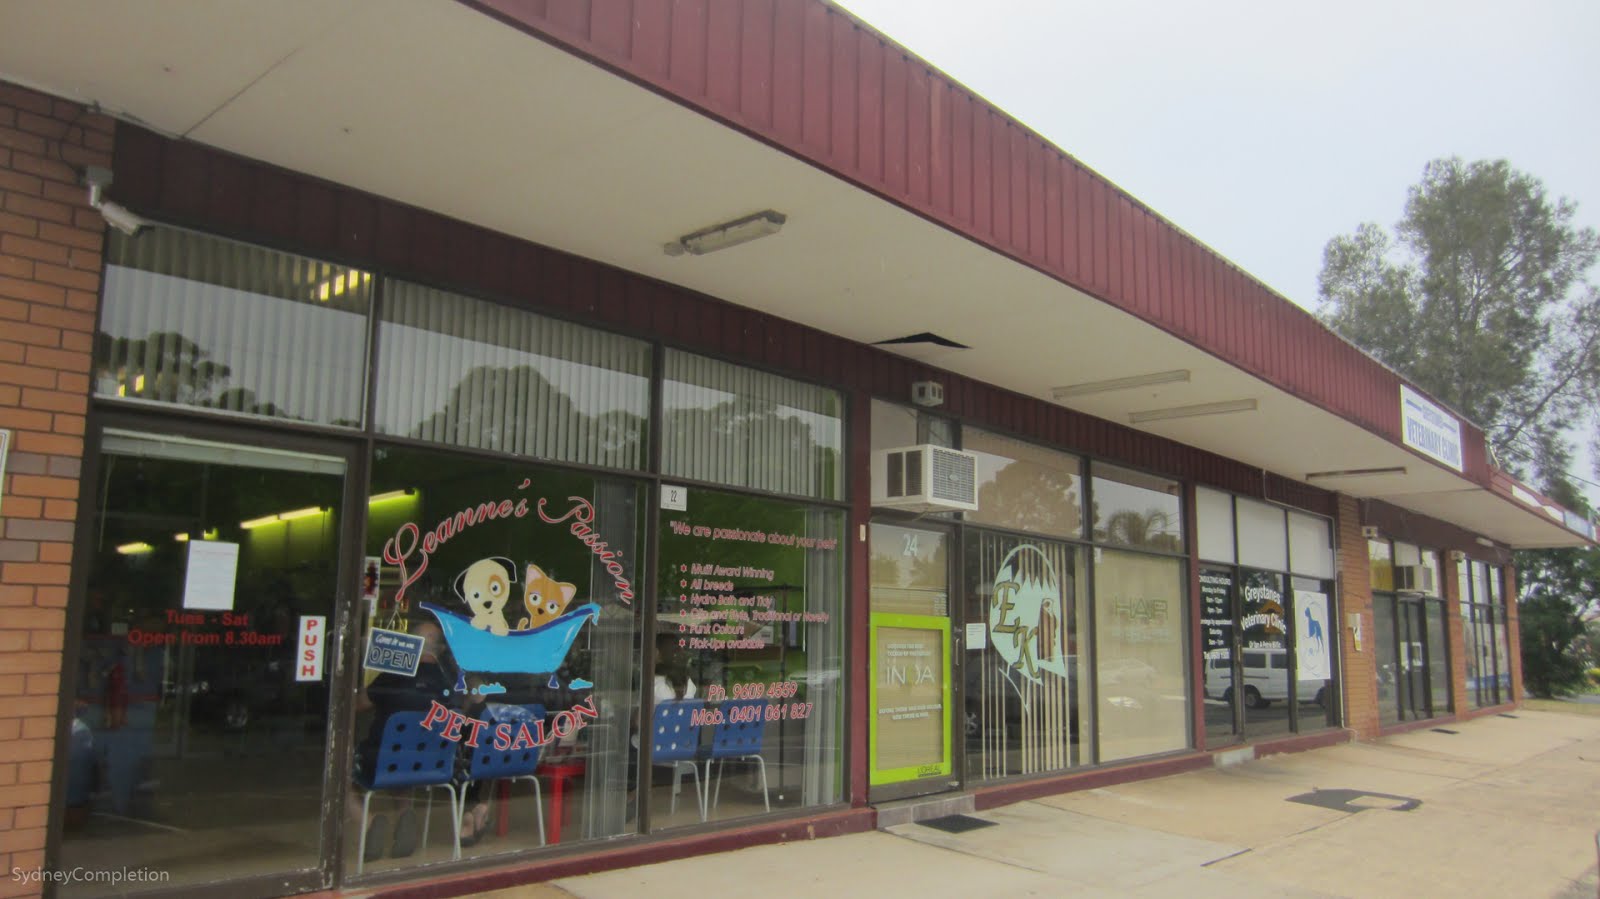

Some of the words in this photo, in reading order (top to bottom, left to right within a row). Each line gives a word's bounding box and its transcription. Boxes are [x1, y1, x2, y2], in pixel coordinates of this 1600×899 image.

[670, 489, 678, 503] 22
[693, 525, 711, 537] are
[713, 527, 766, 543] passionate
[768, 532, 796, 546] about
[902, 533, 918, 557] 24
[538, 496, 635, 604] Passion
[713, 564, 741, 577] Award
[742, 566, 774, 581] Winning
[690, 579, 702, 590] All
[703, 579, 734, 592] breeds
[1244, 585, 1281, 605] Greystanes
[690, 593, 716, 606] Hydro
[738, 595, 755, 607] and
[165, 609, 205, 625] Tues
[222, 611, 249, 626] Sat
[1241, 610, 1270, 631] Veterinary
[1270, 613, 1286, 635] Clinic
[128, 629, 177, 647] Open
[181, 629, 220, 645] from
[224, 631, 282, 646] 8.30am
[302, 619, 318, 677] PUSH
[370, 646, 416, 670] OPEN
[732, 683, 765, 700] 9609
[767, 681, 798, 699] 4559
[420, 700, 488, 748] PET
[493, 695, 599, 751] SALON
[730, 705, 762, 724] 0401
[764, 704, 788, 722] 061
[790, 702, 813, 719] 827
